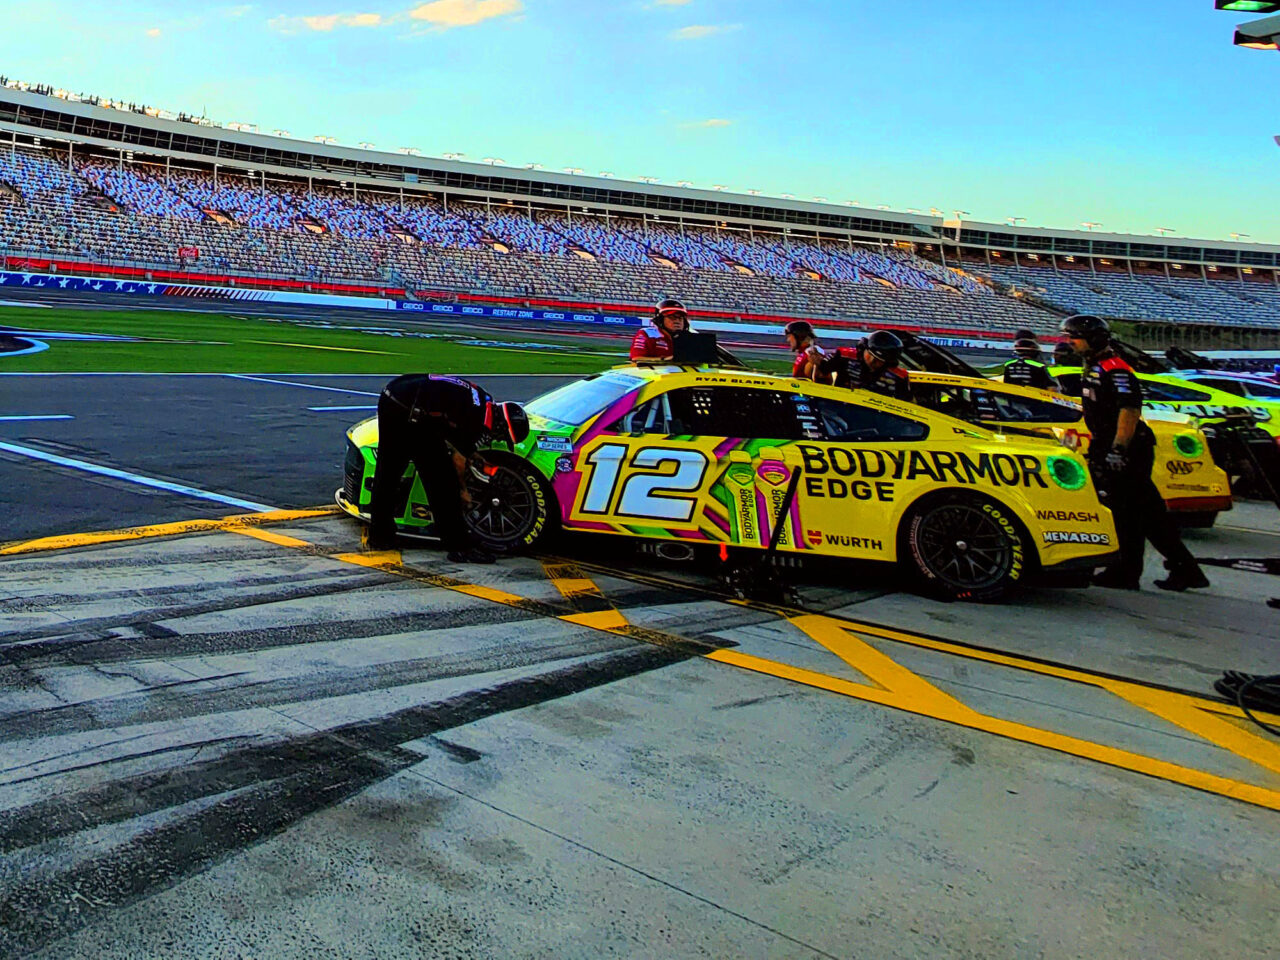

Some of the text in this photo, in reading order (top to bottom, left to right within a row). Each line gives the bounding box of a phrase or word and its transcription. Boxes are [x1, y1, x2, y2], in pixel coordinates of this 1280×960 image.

[492, 309, 517, 317] RESTART
[543, 312, 564, 320] GEICO
[573, 314, 594, 322] GEICO
[603, 316, 625, 324] GEICO
[731, 378, 775, 386] BLANEY
[796, 444, 1049, 488] BODYARMOR
[579, 442, 710, 523] 12
[805, 477, 894, 502] EDGE
[524, 475, 546, 544] GOODYEAR
[740, 488, 754, 539] BODYARMOR
[1035, 510, 1100, 523] WABASH
[825, 534, 883, 551] WÜRTH
[982, 504, 1023, 580] GOODYEAR
[1043, 531, 1110, 544] MENARDS
